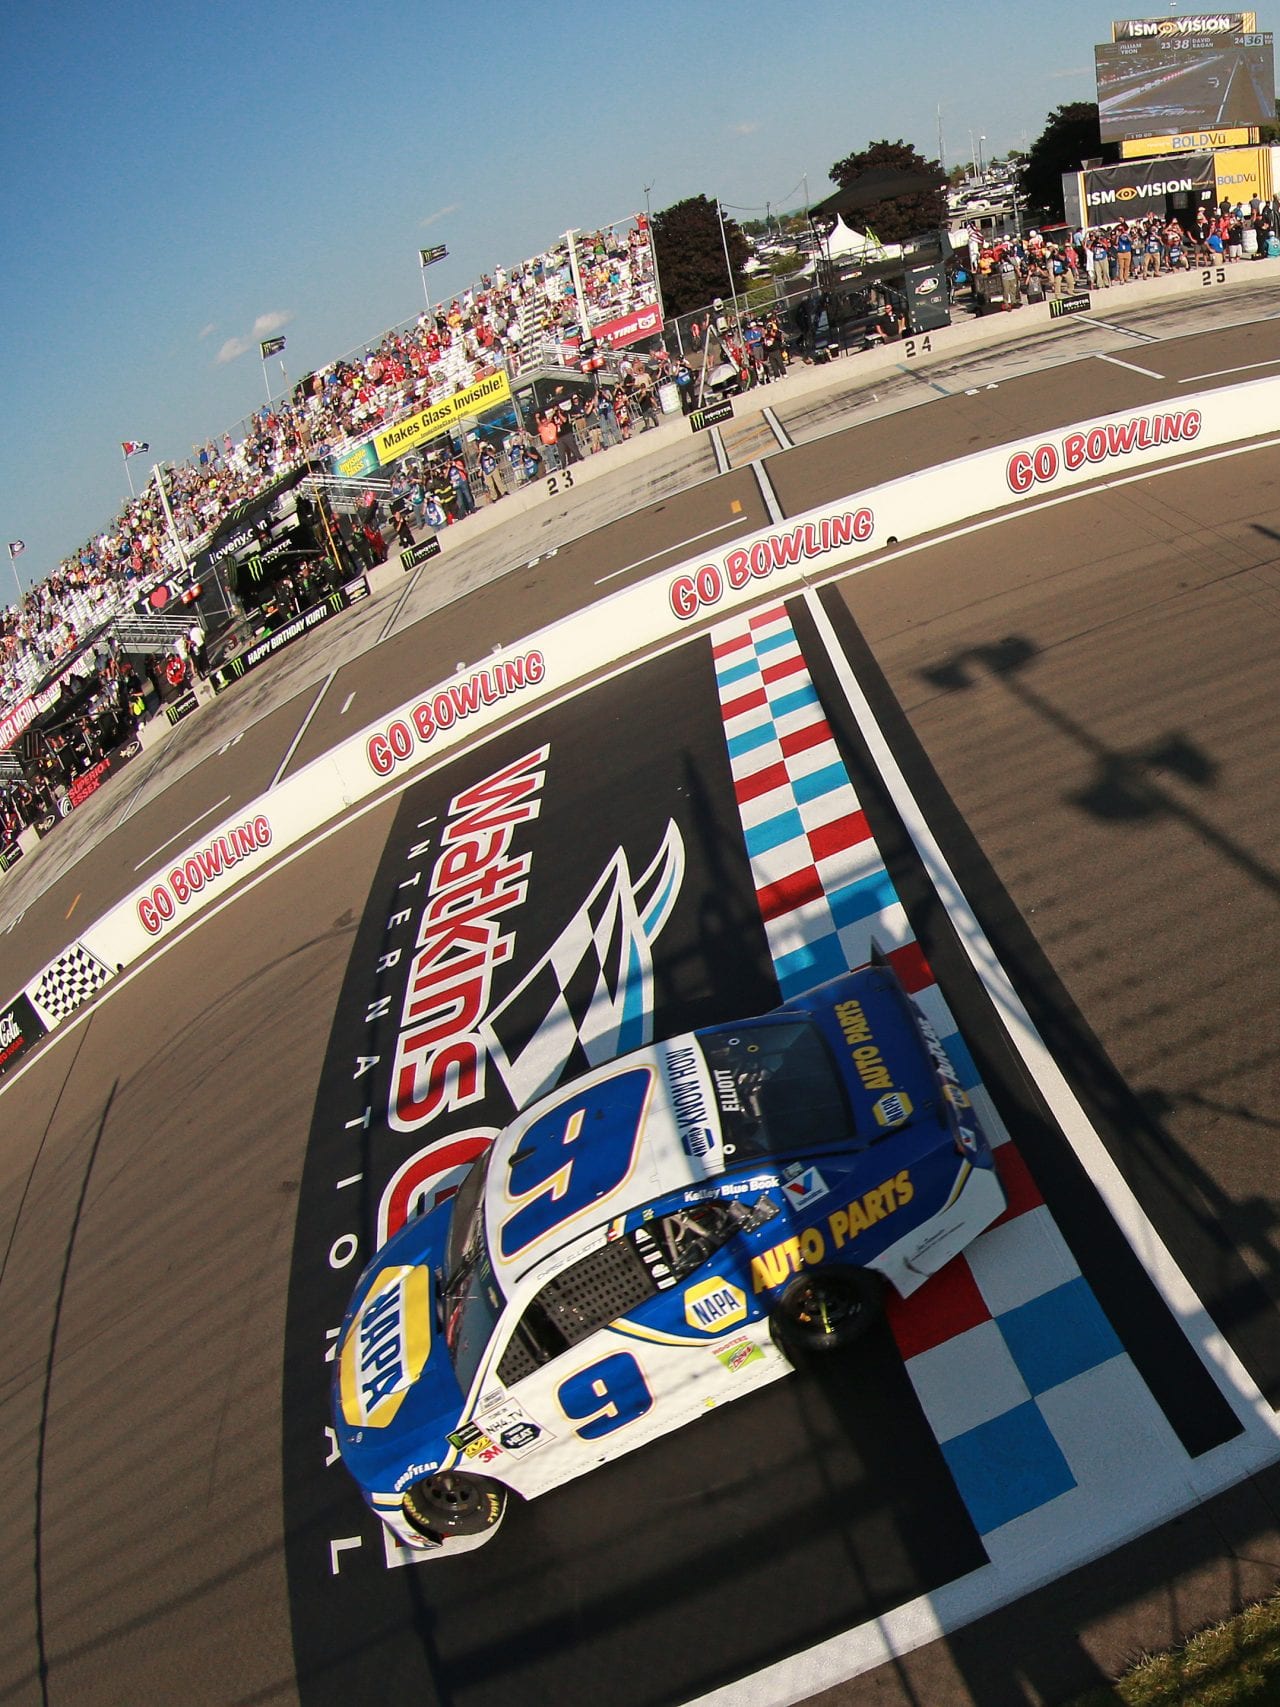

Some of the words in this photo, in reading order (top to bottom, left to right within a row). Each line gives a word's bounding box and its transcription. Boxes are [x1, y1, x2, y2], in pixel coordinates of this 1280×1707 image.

[1129, 22, 1158, 37] ISM
[1176, 18, 1230, 33] VISION
[1173, 39, 1190, 50] 38
[1087, 191, 1116, 207] ISM
[1136, 178, 1193, 198] VISION
[1202, 267, 1226, 286] 25
[904, 335, 933, 358] 24
[382, 418, 420, 449] Makes
[421, 405, 452, 430] Glass
[453, 375, 505, 411] Invisible!
[704, 406, 732, 421] MONSTER
[1006, 443, 1057, 494] GO
[1063, 408, 1203, 471] BOWLING
[545, 470, 575, 496] 23
[413, 541, 440, 559] MONSTER
[669, 563, 724, 620] GO
[723, 506, 875, 590] BOWLING
[247, 641, 270, 666] HAPPY
[270, 618, 306, 651] BIRTHDAY
[366, 719, 413, 776] GO
[410, 649, 546, 744] BOWLING
[72, 778, 101, 807] ESSEX
[136, 885, 175, 936] GO
[169, 814, 273, 905] BOWLING
[386, 742, 553, 1134] Watkins
[834, 1000, 873, 1045] PARTS
[665, 1047, 697, 1081] HOW
[852, 1046, 894, 1090] AUTO
[671, 1080, 708, 1129] KNOW
[713, 1069, 740, 1112] ELLIOTT
[882, 1095, 904, 1122] NAPA
[688, 1129, 709, 1155] NAPA
[499, 1062, 660, 1266] 9
[684, 1184, 720, 1202] Kelley
[721, 1180, 748, 1196] Blue
[749, 1177, 780, 1192] Book
[750, 1227, 825, 1294] AUTO
[828, 1169, 915, 1250] PARTS
[692, 1288, 741, 1326] NAPA
[361, 1282, 404, 1414] NAPA
[556, 1348, 656, 1441] 9
[478, 1445, 504, 1464] 3M
